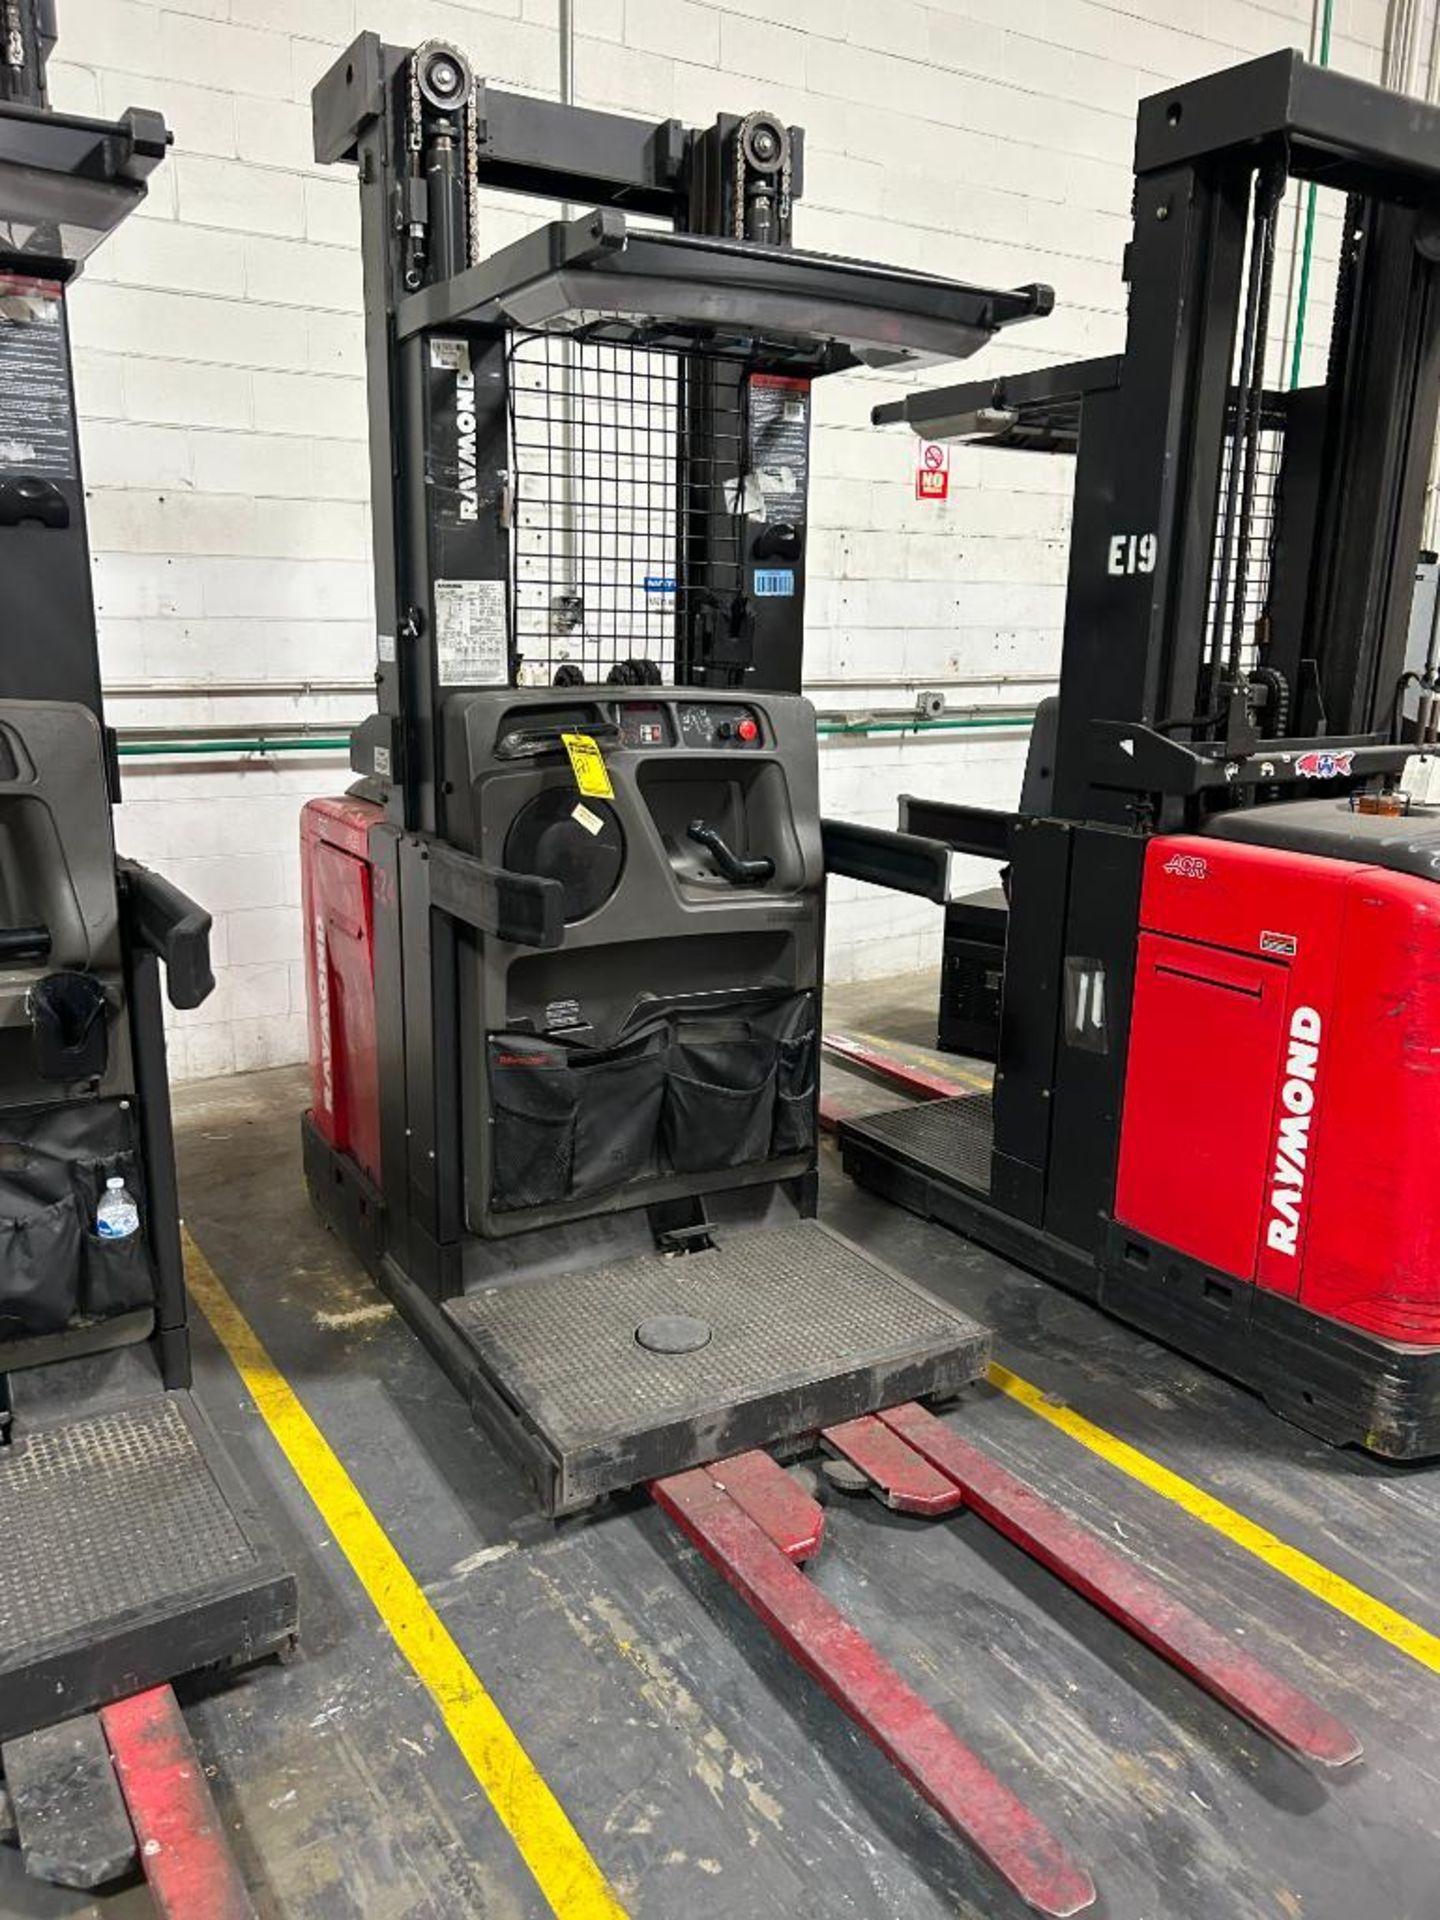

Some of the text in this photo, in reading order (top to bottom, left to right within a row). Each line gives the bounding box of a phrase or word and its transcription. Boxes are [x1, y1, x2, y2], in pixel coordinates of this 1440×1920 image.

[456, 369, 478, 520] RAYMOND
[922, 471, 944, 487] NO
[1107, 533, 1158, 575] E19
[1266, 1006, 1322, 1257] RAYMOND
